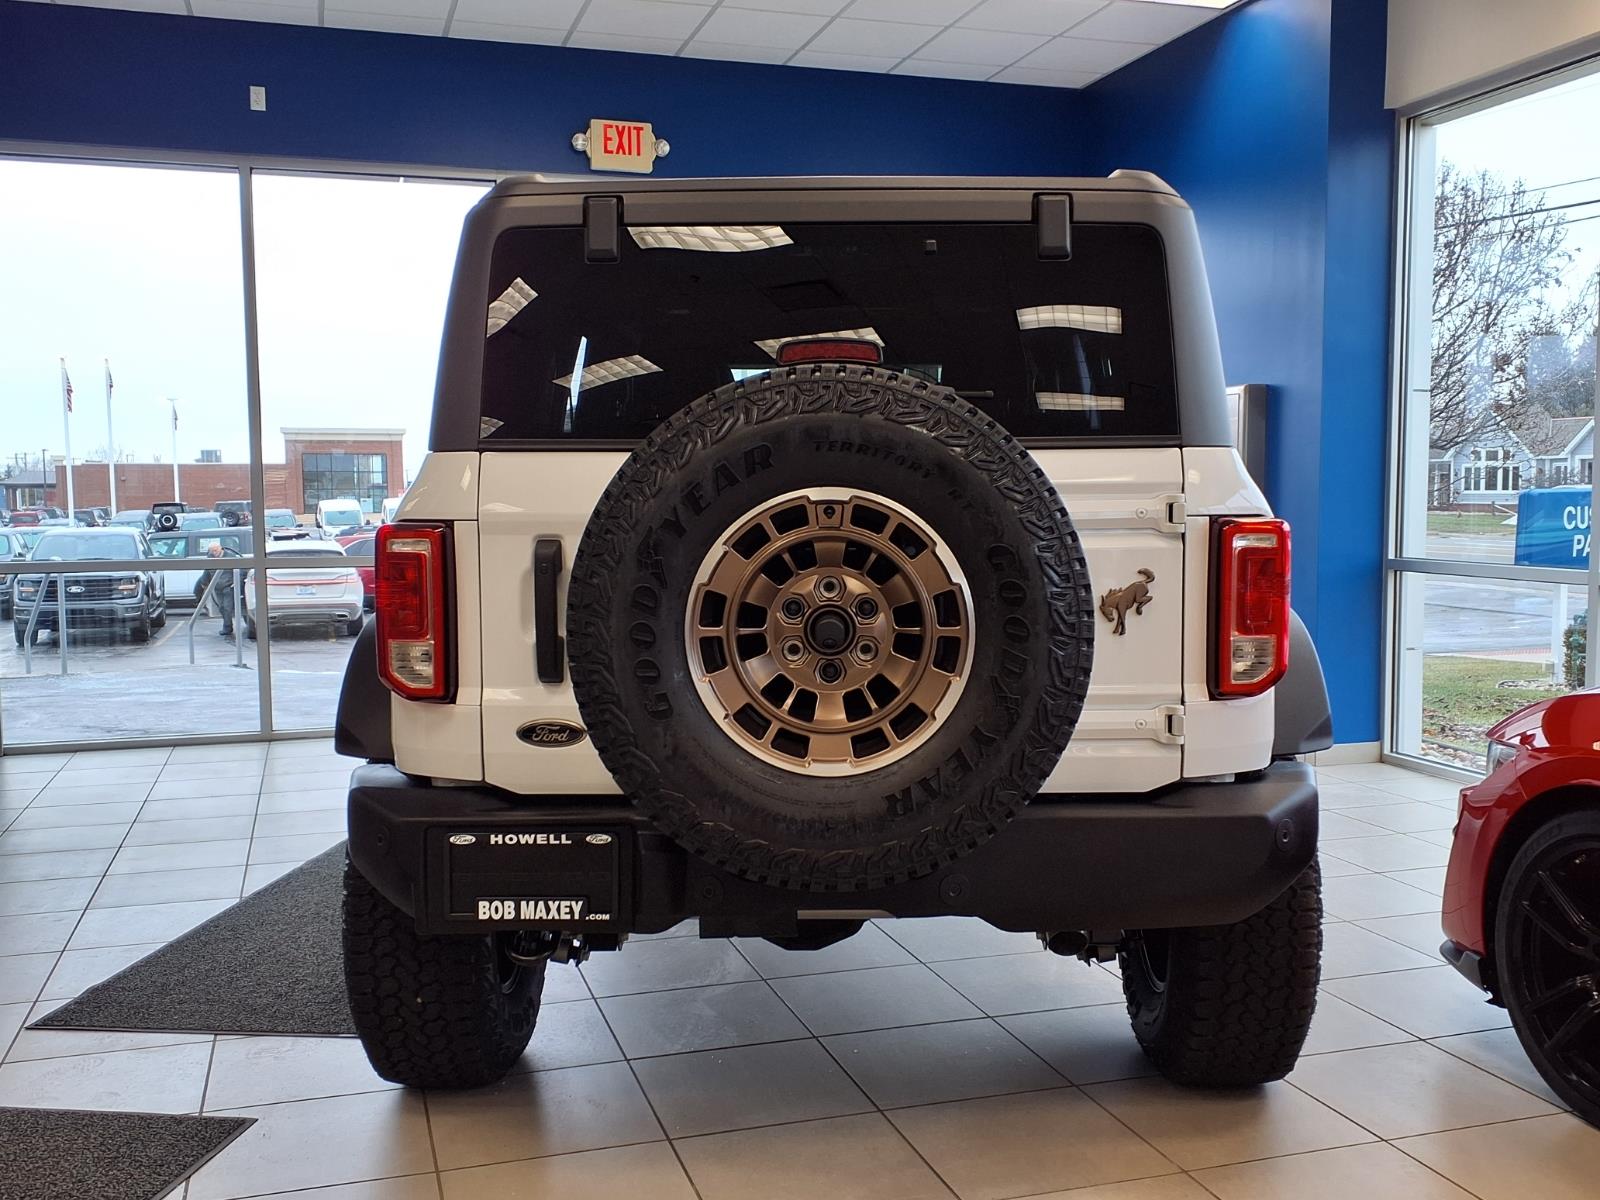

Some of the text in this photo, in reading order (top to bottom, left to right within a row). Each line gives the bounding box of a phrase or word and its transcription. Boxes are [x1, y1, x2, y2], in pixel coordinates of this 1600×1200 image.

[602, 123, 644, 156] EXIT
[813, 440, 936, 479] TERRITORY
[1563, 505, 1592, 530] CU
[630, 442, 775, 720] GOODYEAR
[885, 543, 1031, 818] GOODYEAR
[532, 725, 570, 741] Ford
[450, 835, 475, 844] Ford
[489, 833, 572, 845] HOWELL
[586, 834, 611, 844] Ford
[478, 900, 515, 920] BOB
[520, 900, 584, 920] MAXEY
